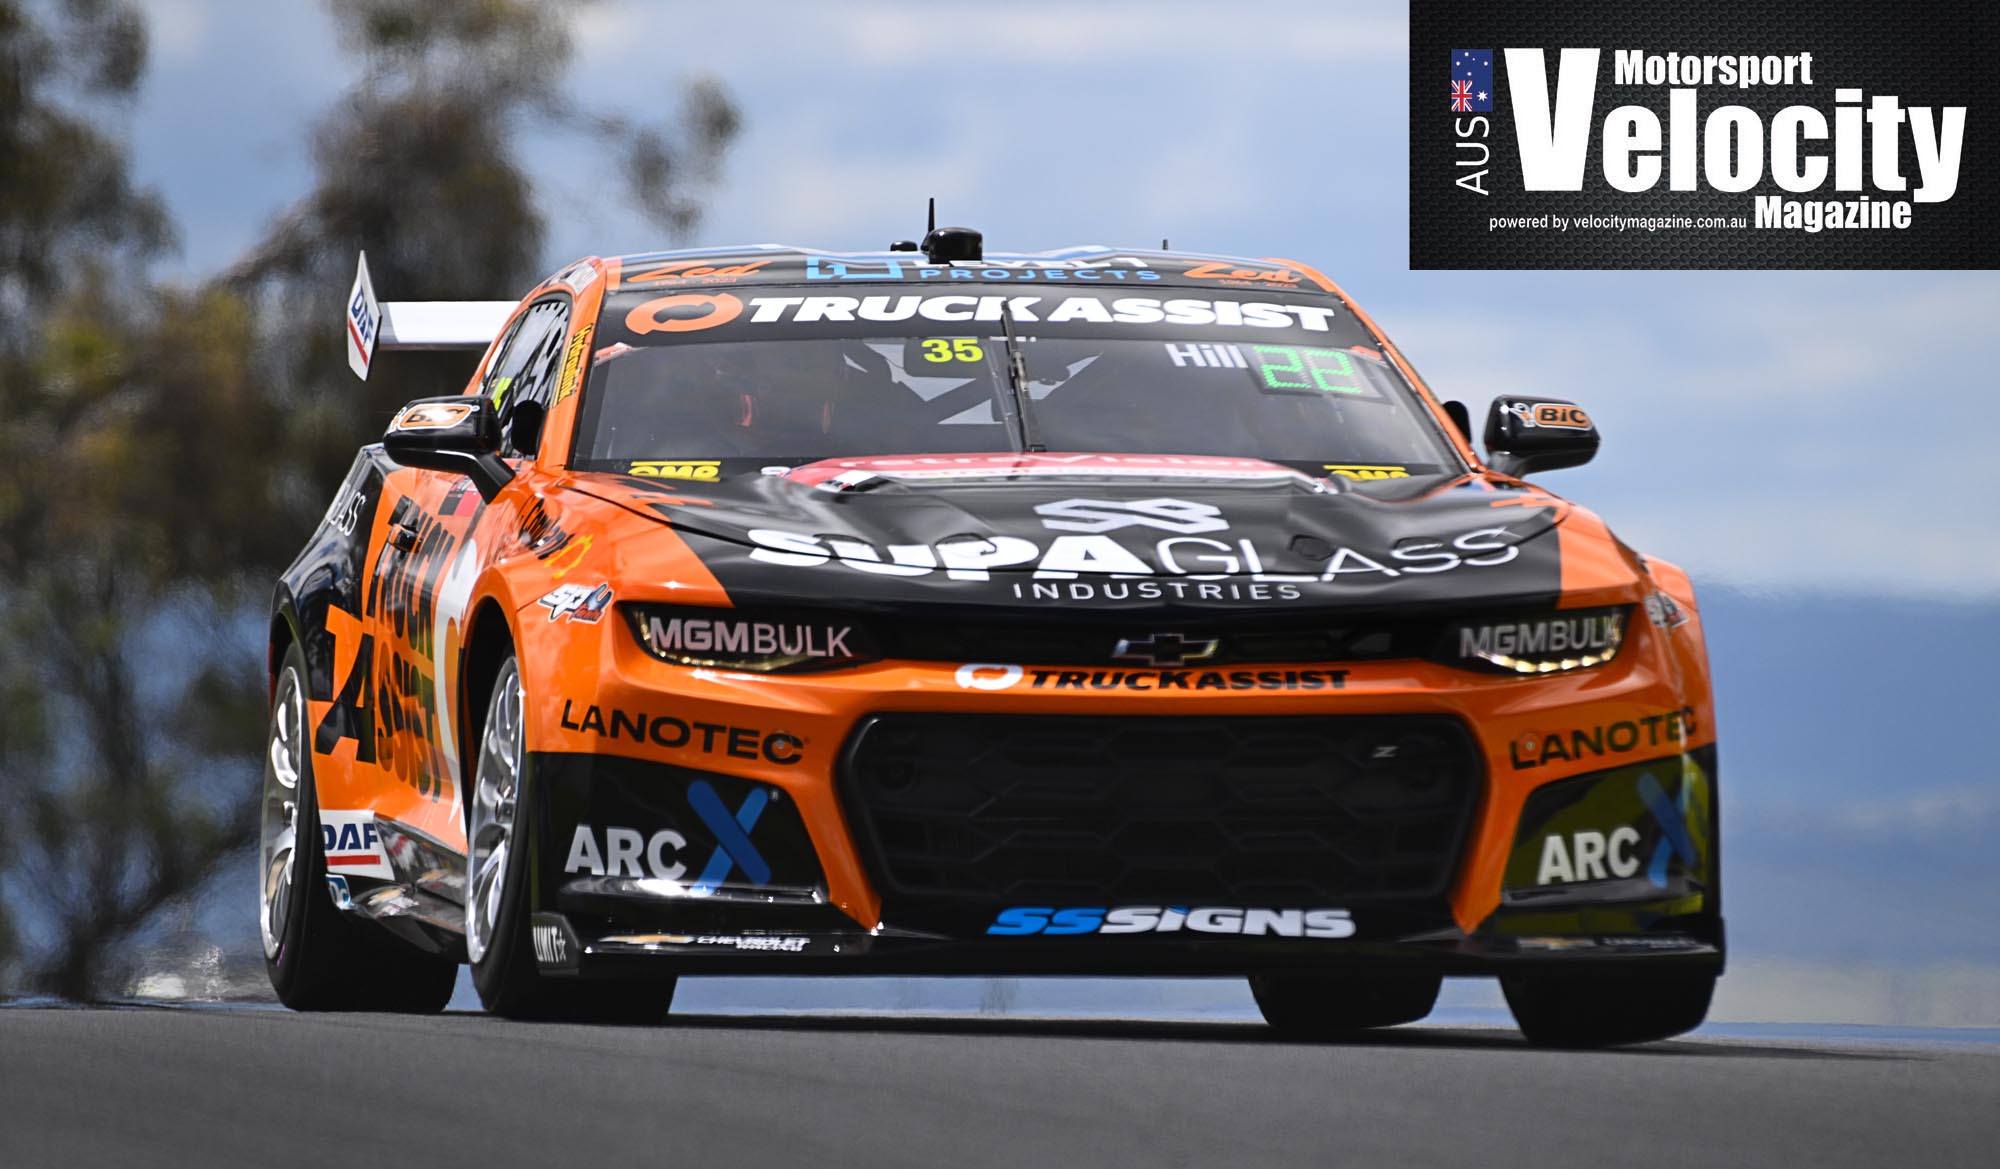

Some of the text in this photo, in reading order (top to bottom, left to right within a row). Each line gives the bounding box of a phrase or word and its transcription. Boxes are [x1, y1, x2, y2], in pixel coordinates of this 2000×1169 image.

[919, 268, 1161, 281] PROJECTS
[921, 339, 984, 362] 35
[1164, 343, 1249, 369] Hill
[1253, 345, 1361, 393] 22
[1013, 583, 1301, 600] INDUSTRIES
[650, 617, 852, 657] MGMBULK
[561, 699, 803, 764] LANOTEC
[1510, 706, 1696, 770] LANOTEC
